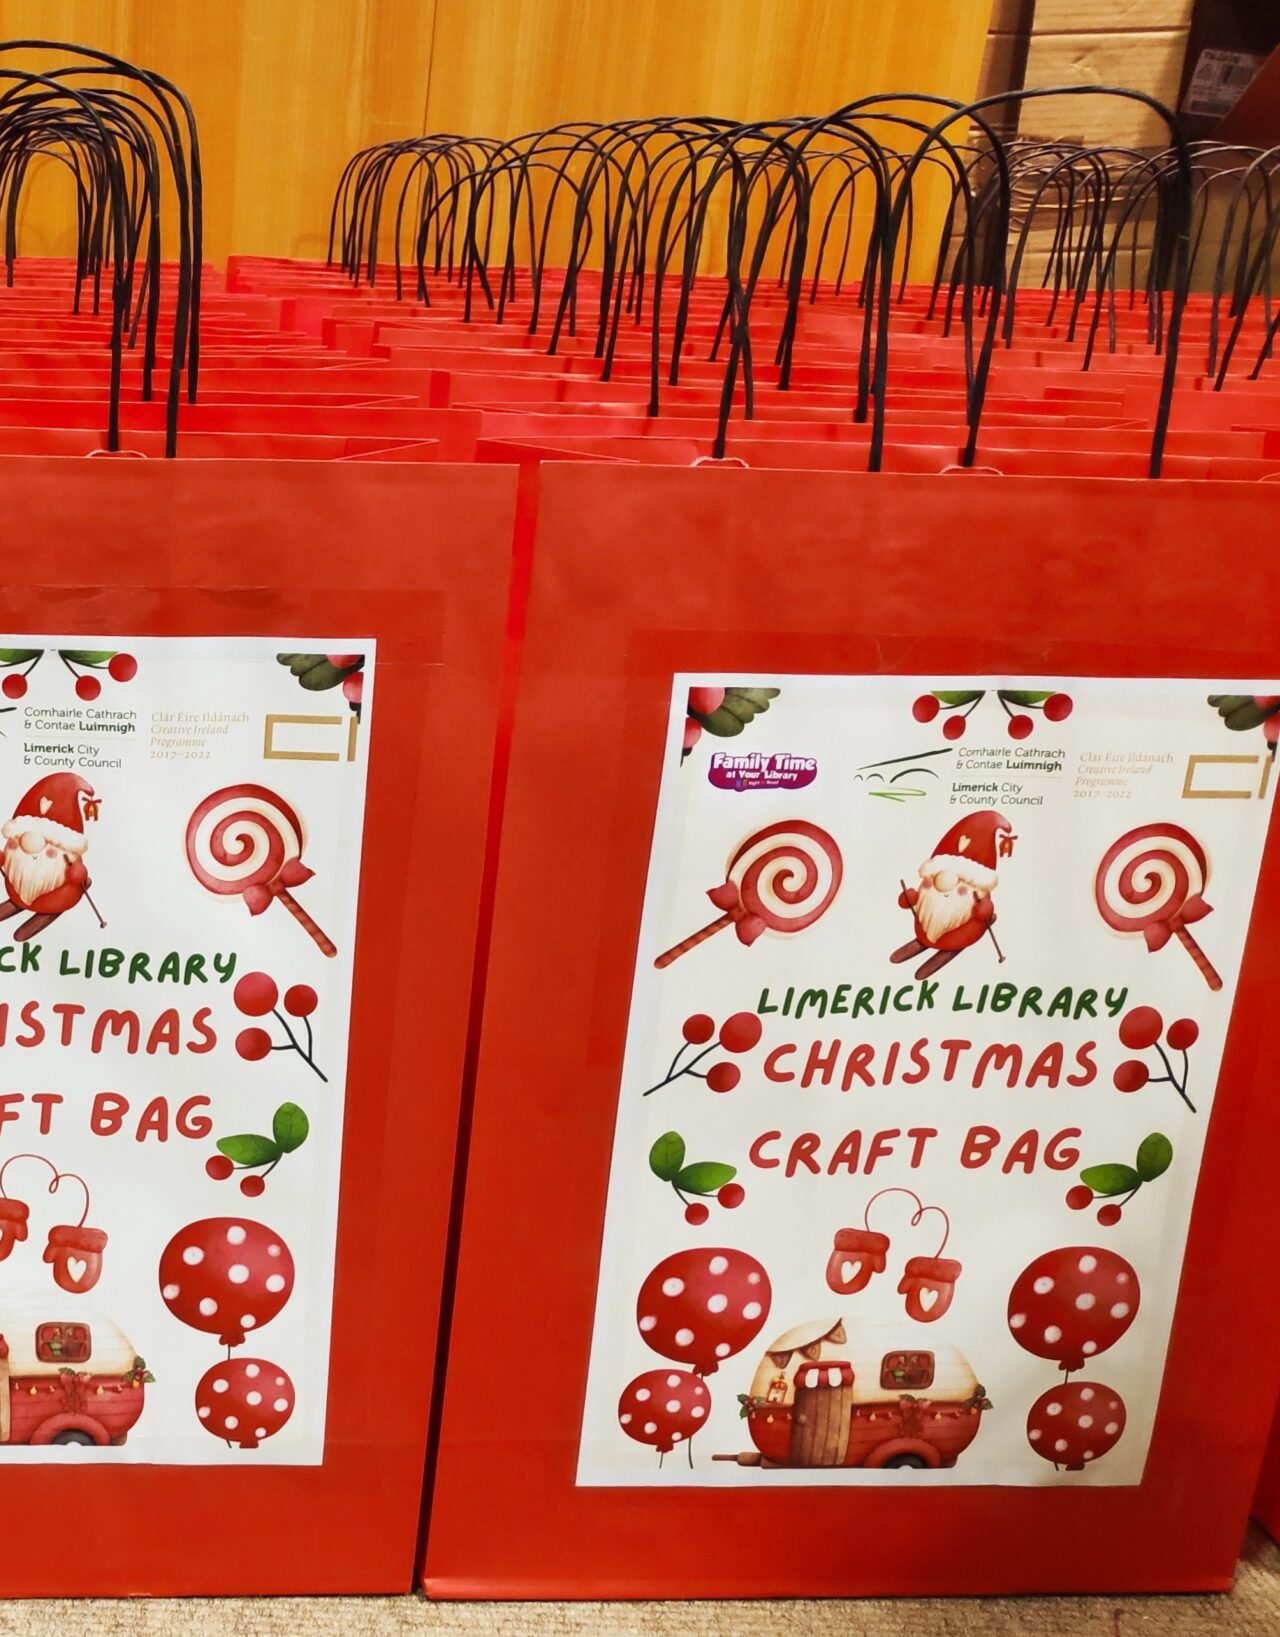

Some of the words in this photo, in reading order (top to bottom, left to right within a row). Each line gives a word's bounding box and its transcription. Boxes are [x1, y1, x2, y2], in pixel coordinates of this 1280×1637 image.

[24, 707, 83, 718] Comhairle
[86, 708, 137, 720] Cathrach
[24, 719, 32, 729] &
[35, 720, 76, 731] Contae
[79, 721, 136, 734] Luimnigh
[150, 724, 192, 735] Creative
[193, 724, 229, 735] Ireland
[150, 736, 206, 749] Programme
[23, 742, 75, 754] Limerick
[77, 744, 100, 758] City
[958, 747, 1011, 757] Comhairle
[1014, 748, 1065, 759] Cathrach
[23, 756, 31, 766] &
[34, 756, 76, 769] County
[78, 757, 122, 768] Council
[713, 753, 771, 772] Family
[774, 754, 816, 771] Time
[956, 760, 963, 770] &
[966, 760, 1003, 770] Contae
[1006, 760, 1062, 773] Luimnigh
[725, 770, 736, 779] at
[738, 770, 760, 779] Your
[764, 771, 798, 781] Library
[952, 782, 999, 793] Limerick
[1001, 782, 1024, 795] City
[949, 795, 957, 804] &
[959, 795, 998, 807] County
[1001, 796, 1043, 806] Council
[59, 948, 237, 985] LIBRARY
[757, 981, 940, 1019] LIMERICK
[951, 982, 1129, 1019] LIBRARY
[763, 1038, 1098, 1092] CHRISTMAS
[90, 1092, 213, 1142] BAG
[749, 1127, 938, 1178] CRAFT
[960, 1125, 1082, 1175] BAG
